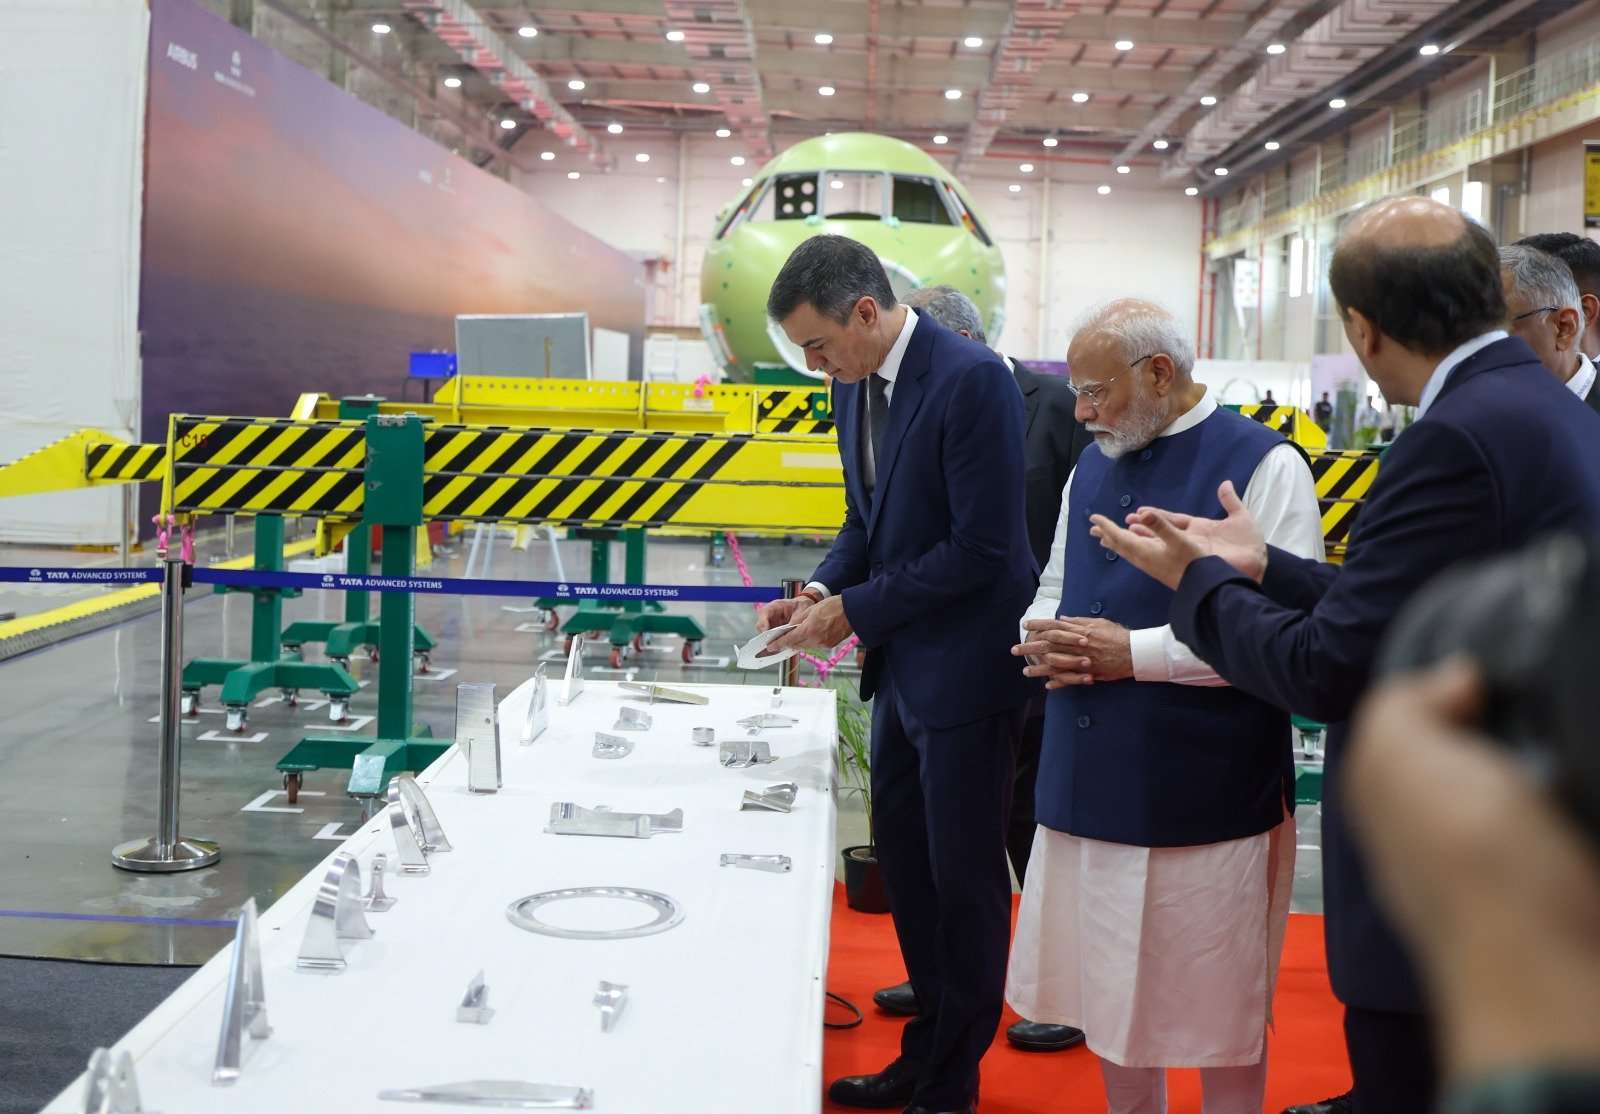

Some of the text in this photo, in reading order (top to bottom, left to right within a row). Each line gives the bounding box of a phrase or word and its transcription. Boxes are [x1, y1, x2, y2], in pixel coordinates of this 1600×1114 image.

[46, 571, 147, 580] TATA ADVANCED SYSTEMS
[339, 577, 442, 589] TATA ADVANCED SYSTEMS
[574, 586, 679, 597] TATA ADVANCED SYSTEMS
